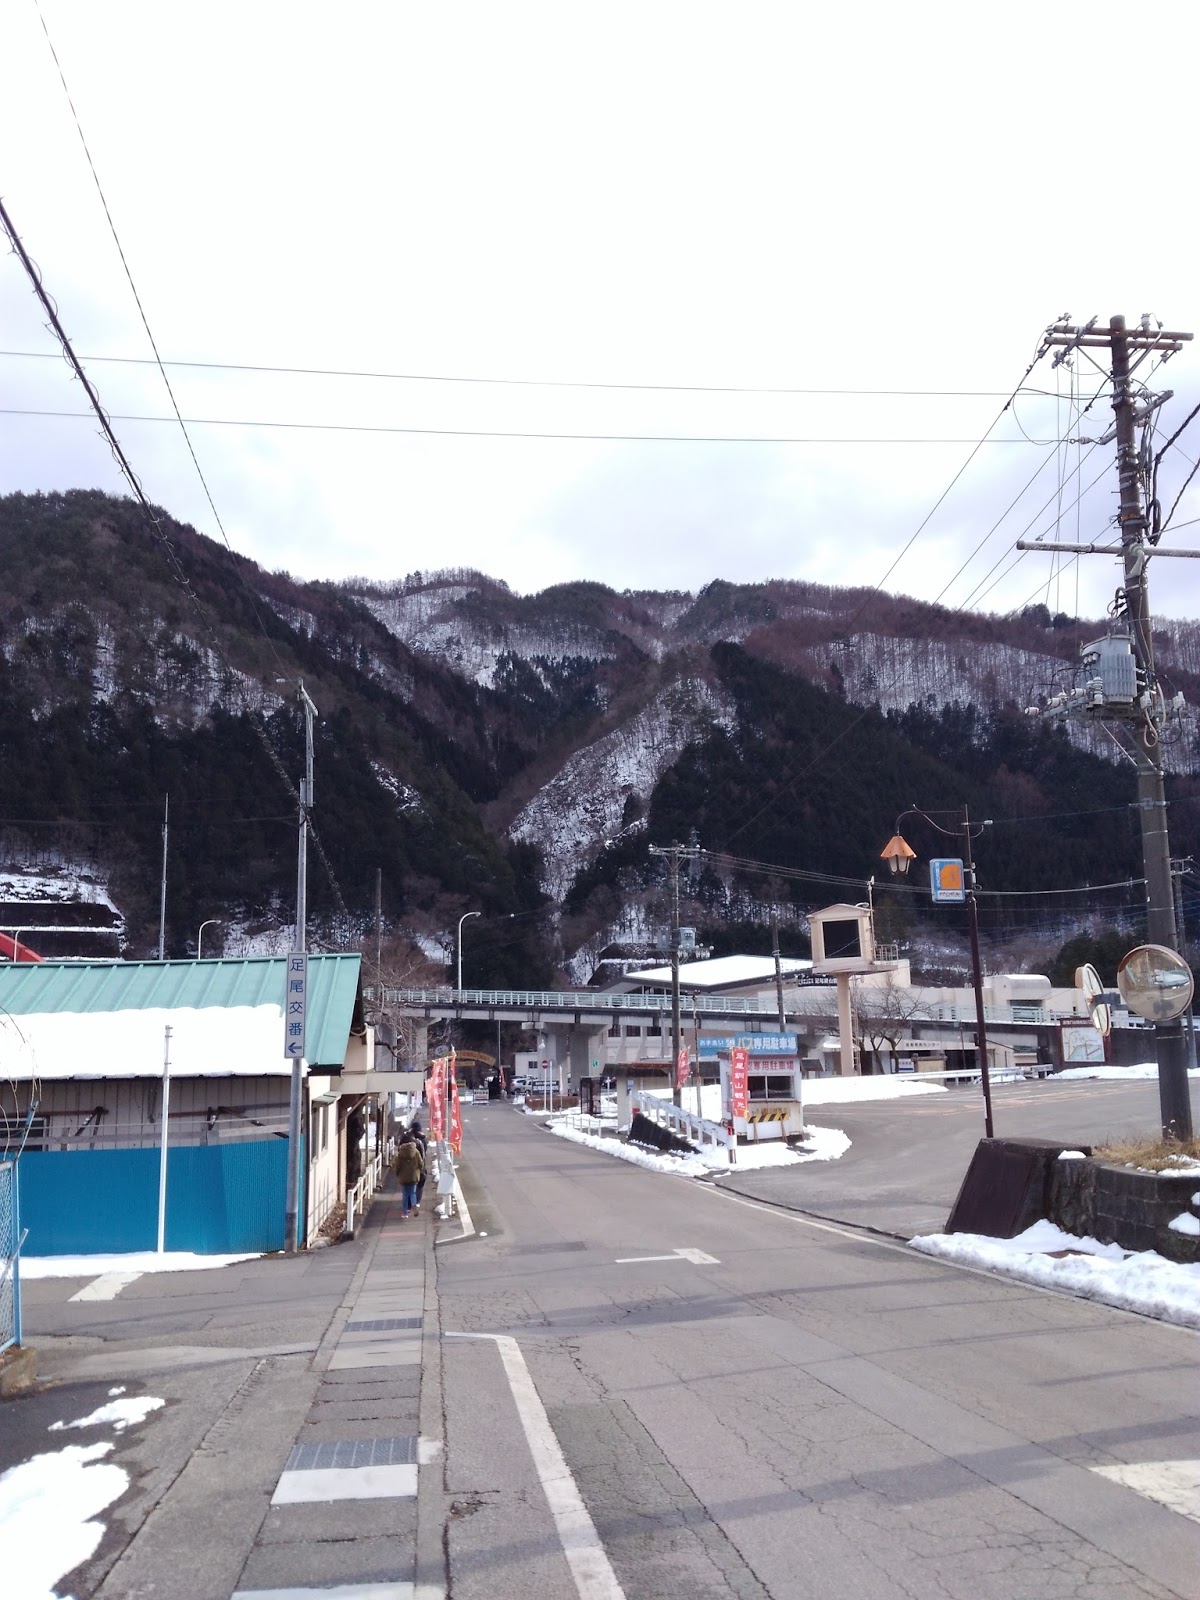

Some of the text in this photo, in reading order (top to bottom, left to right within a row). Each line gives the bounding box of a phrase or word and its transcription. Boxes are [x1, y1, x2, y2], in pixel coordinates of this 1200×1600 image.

[289, 958, 304, 1036] 足尾交番
[737, 1036, 797, 1050] バス専用駐車場
[734, 1052, 746, 1109] 足尾銅山観光
